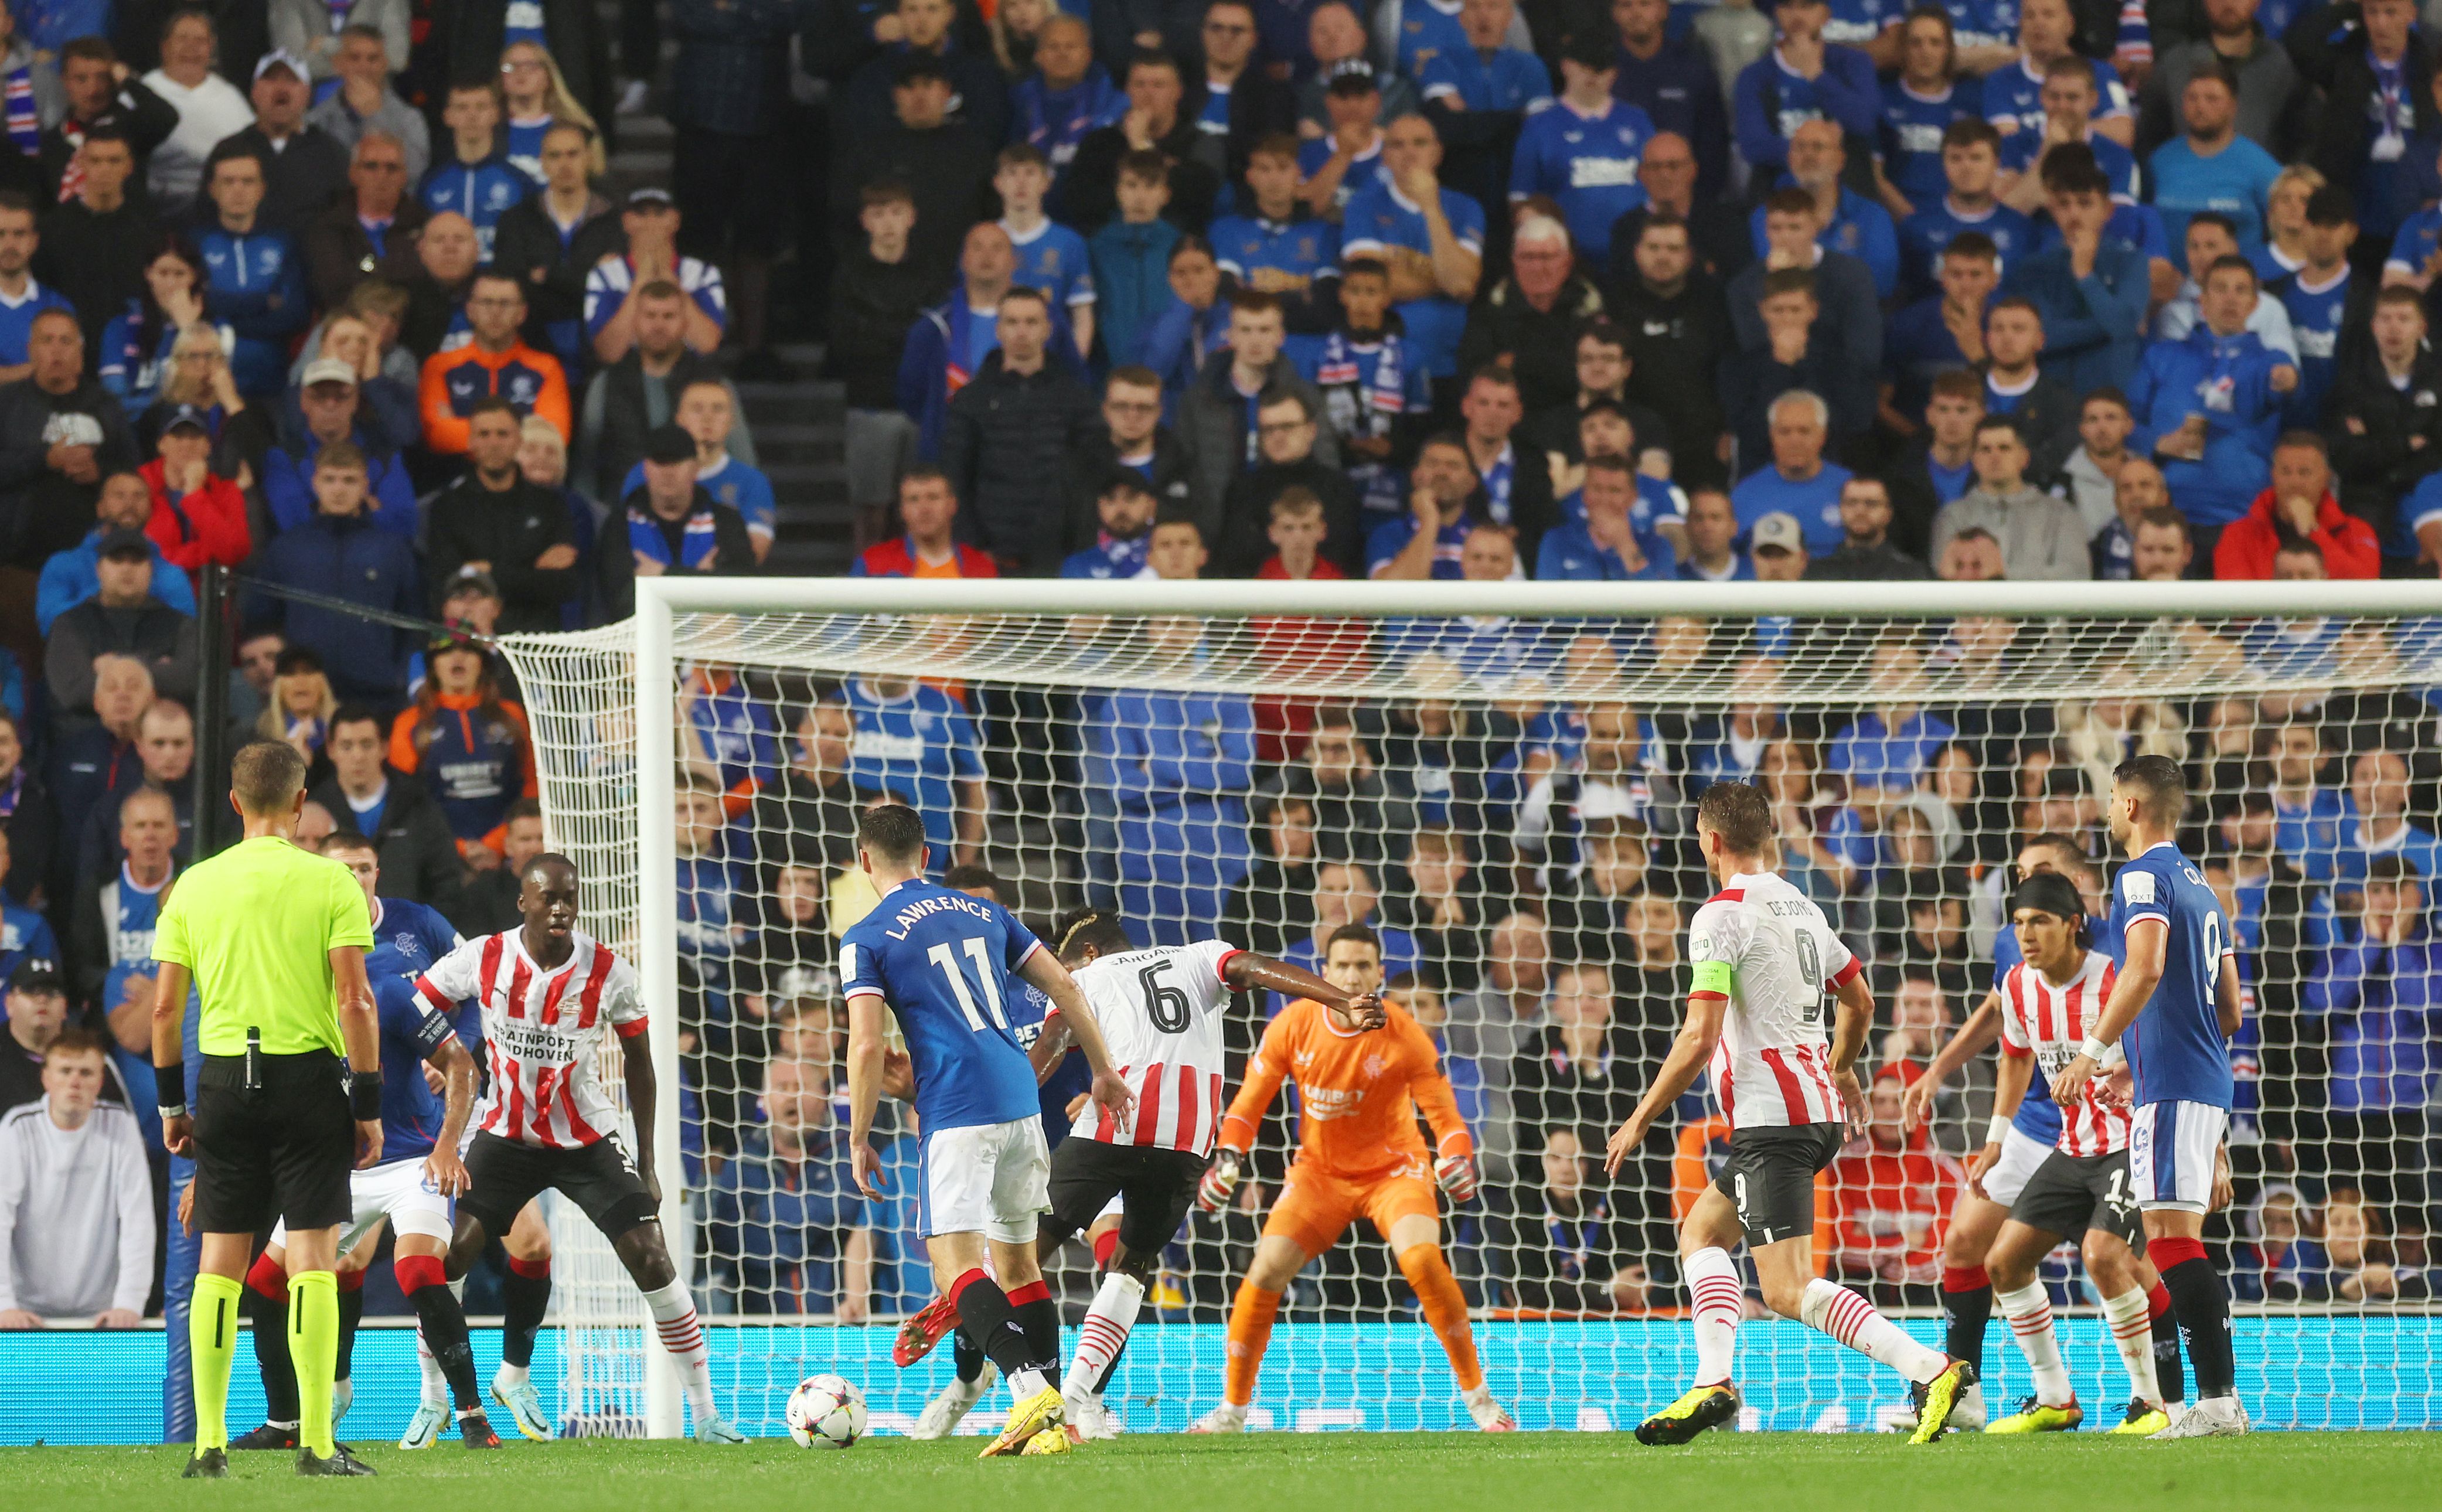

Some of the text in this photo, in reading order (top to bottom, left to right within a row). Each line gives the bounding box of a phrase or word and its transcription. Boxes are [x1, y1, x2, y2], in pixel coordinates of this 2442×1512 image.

[885, 896, 992, 941] LAWRENCE
[1766, 900, 1813, 916] DE JONG
[1692, 939, 1709, 951] TOTO
[2203, 911, 2221, 1005] 9
[927, 937, 1007, 1032] 11
[1795, 928, 1825, 1021] 9
[1139, 959, 1191, 1033] 6
[418, 1029, 427, 1038] NO
[492, 1023, 575, 1050] BRAINPORT
[495, 1033, 575, 1061] EINDHOVEN
[1734, 1173, 1747, 1213] 9
